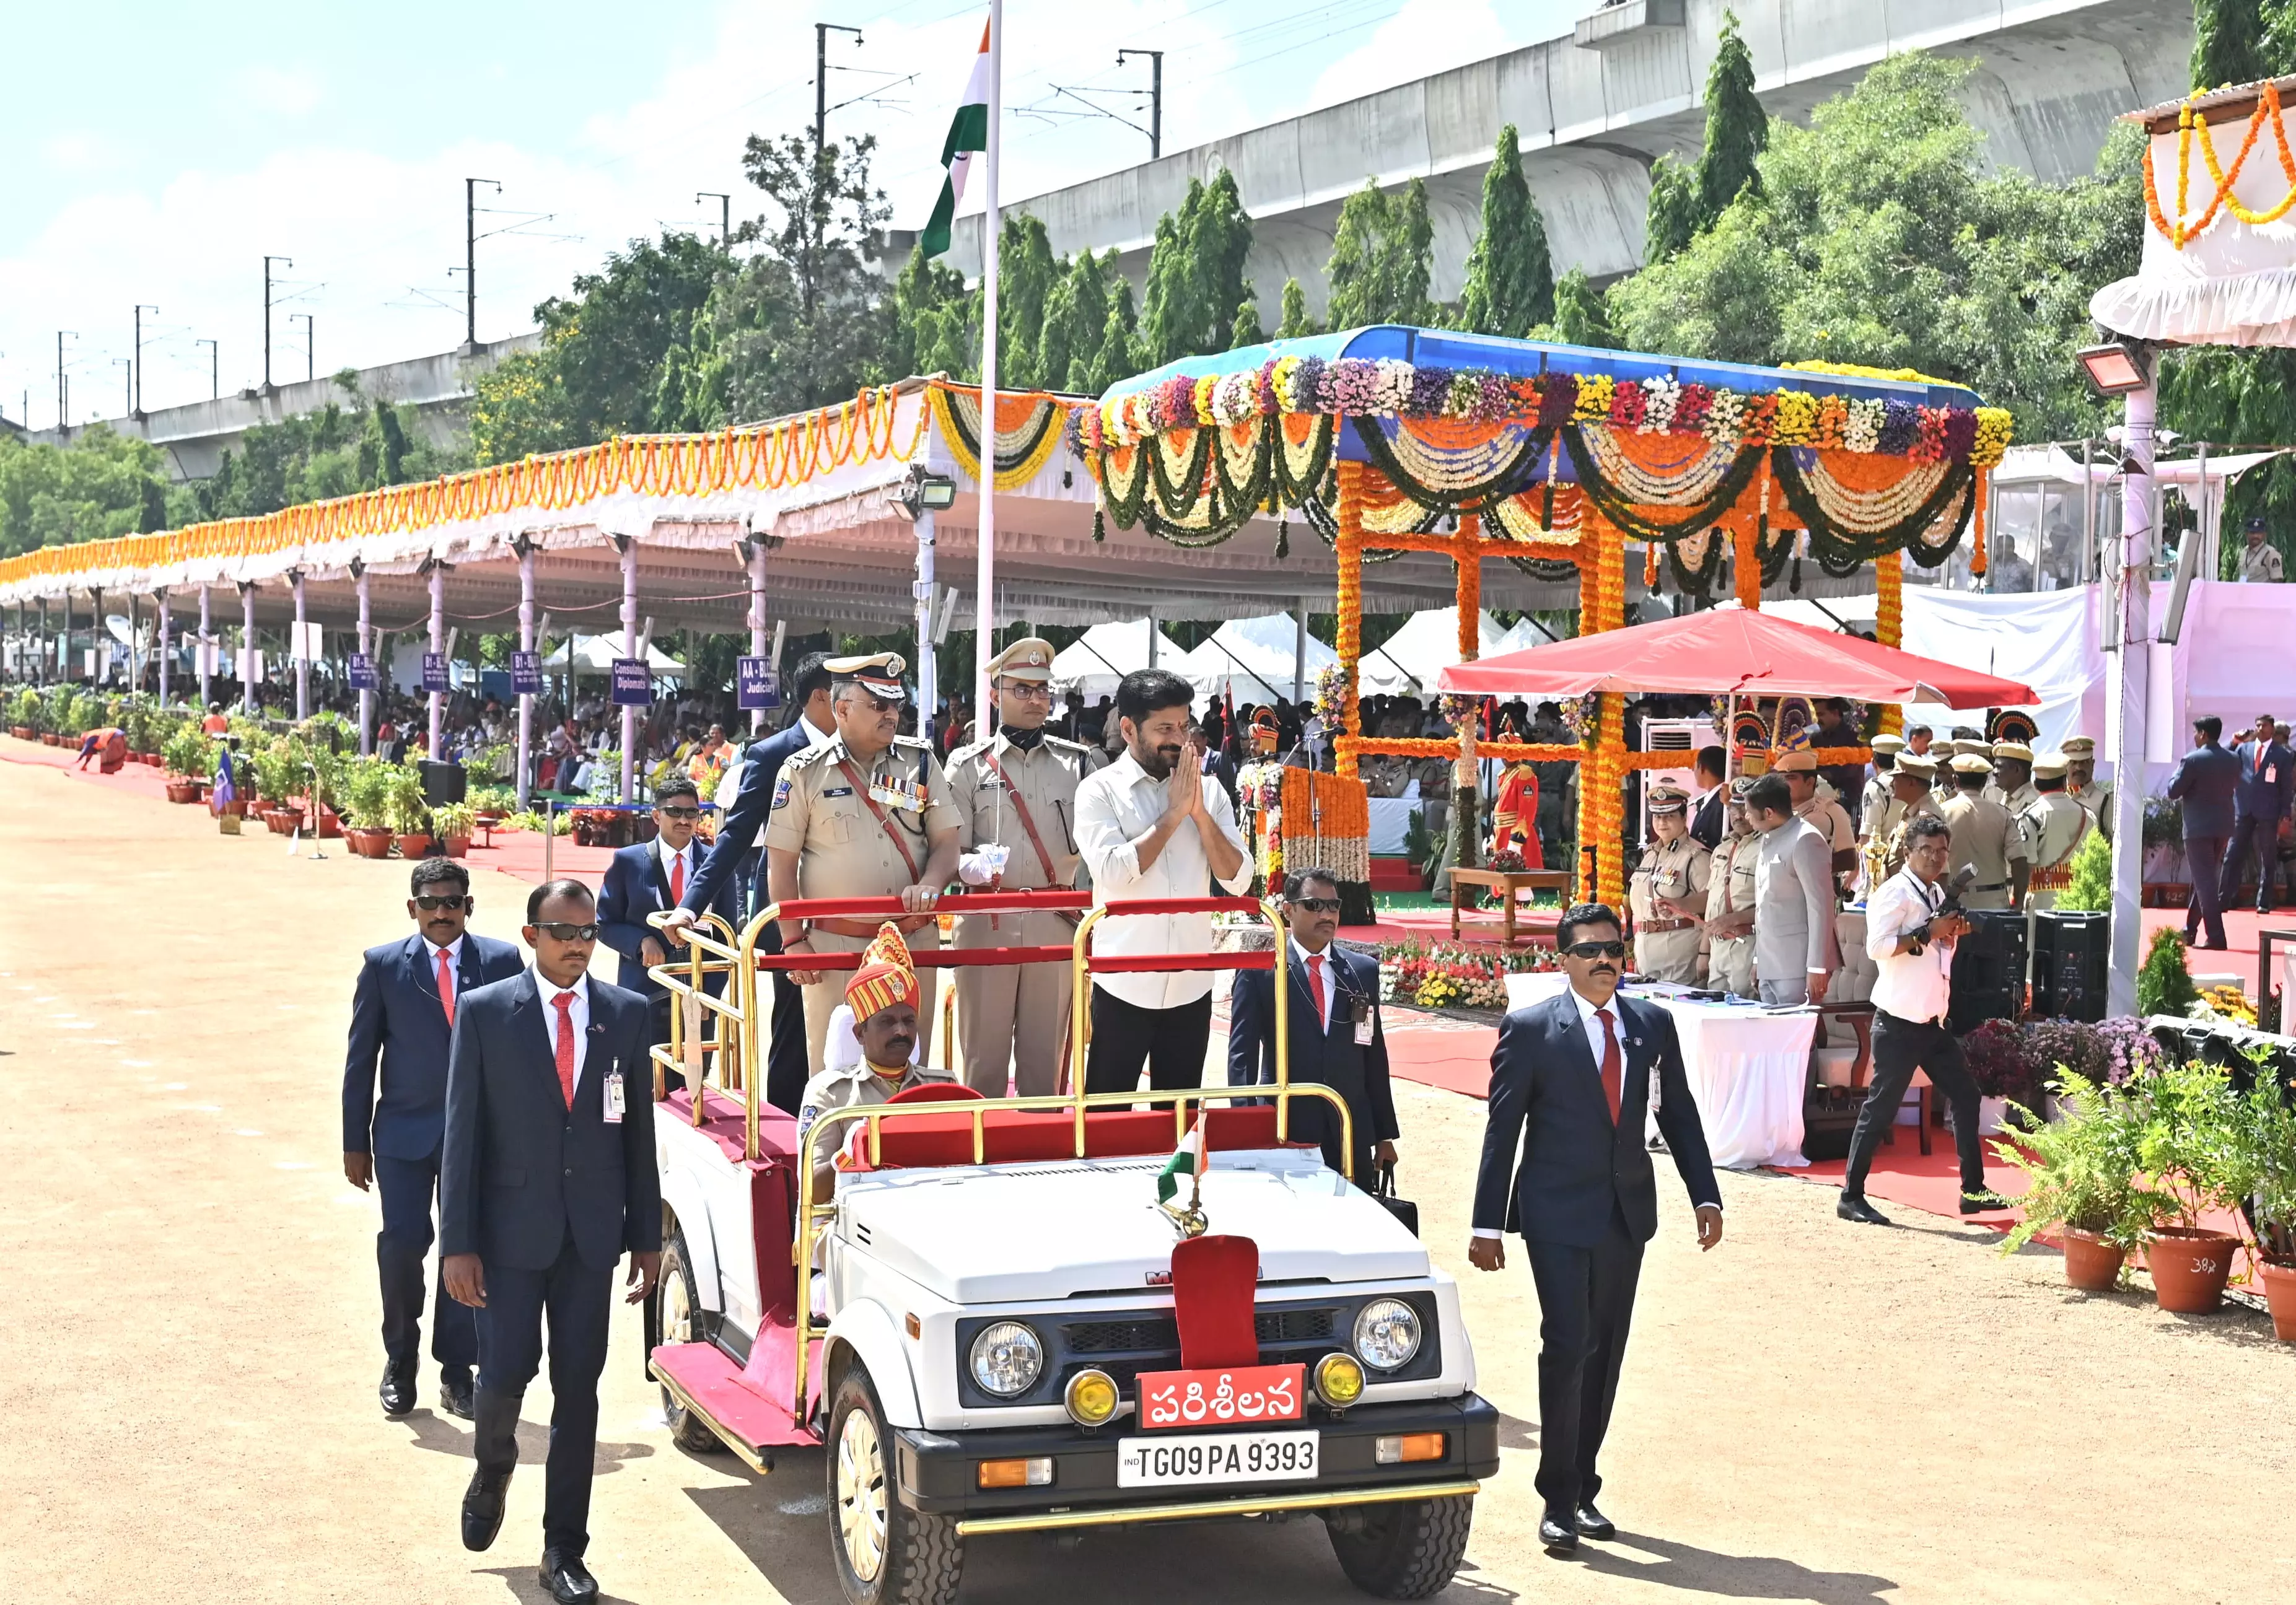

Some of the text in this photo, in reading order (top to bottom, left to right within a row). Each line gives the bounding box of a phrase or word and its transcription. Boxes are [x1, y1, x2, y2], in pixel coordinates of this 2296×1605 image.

[615, 662, 646, 675] Consulates
[743, 661, 753, 678] AA
[618, 676, 646, 691] Diplomats
[747, 681, 775, 696] Judiciary
[1151, 1373, 1295, 1423] పరిశీలన
[1137, 1446, 1202, 1477] TG09
[1209, 1444, 1241, 1474] PA
[1248, 1441, 1313, 1472] 9393
